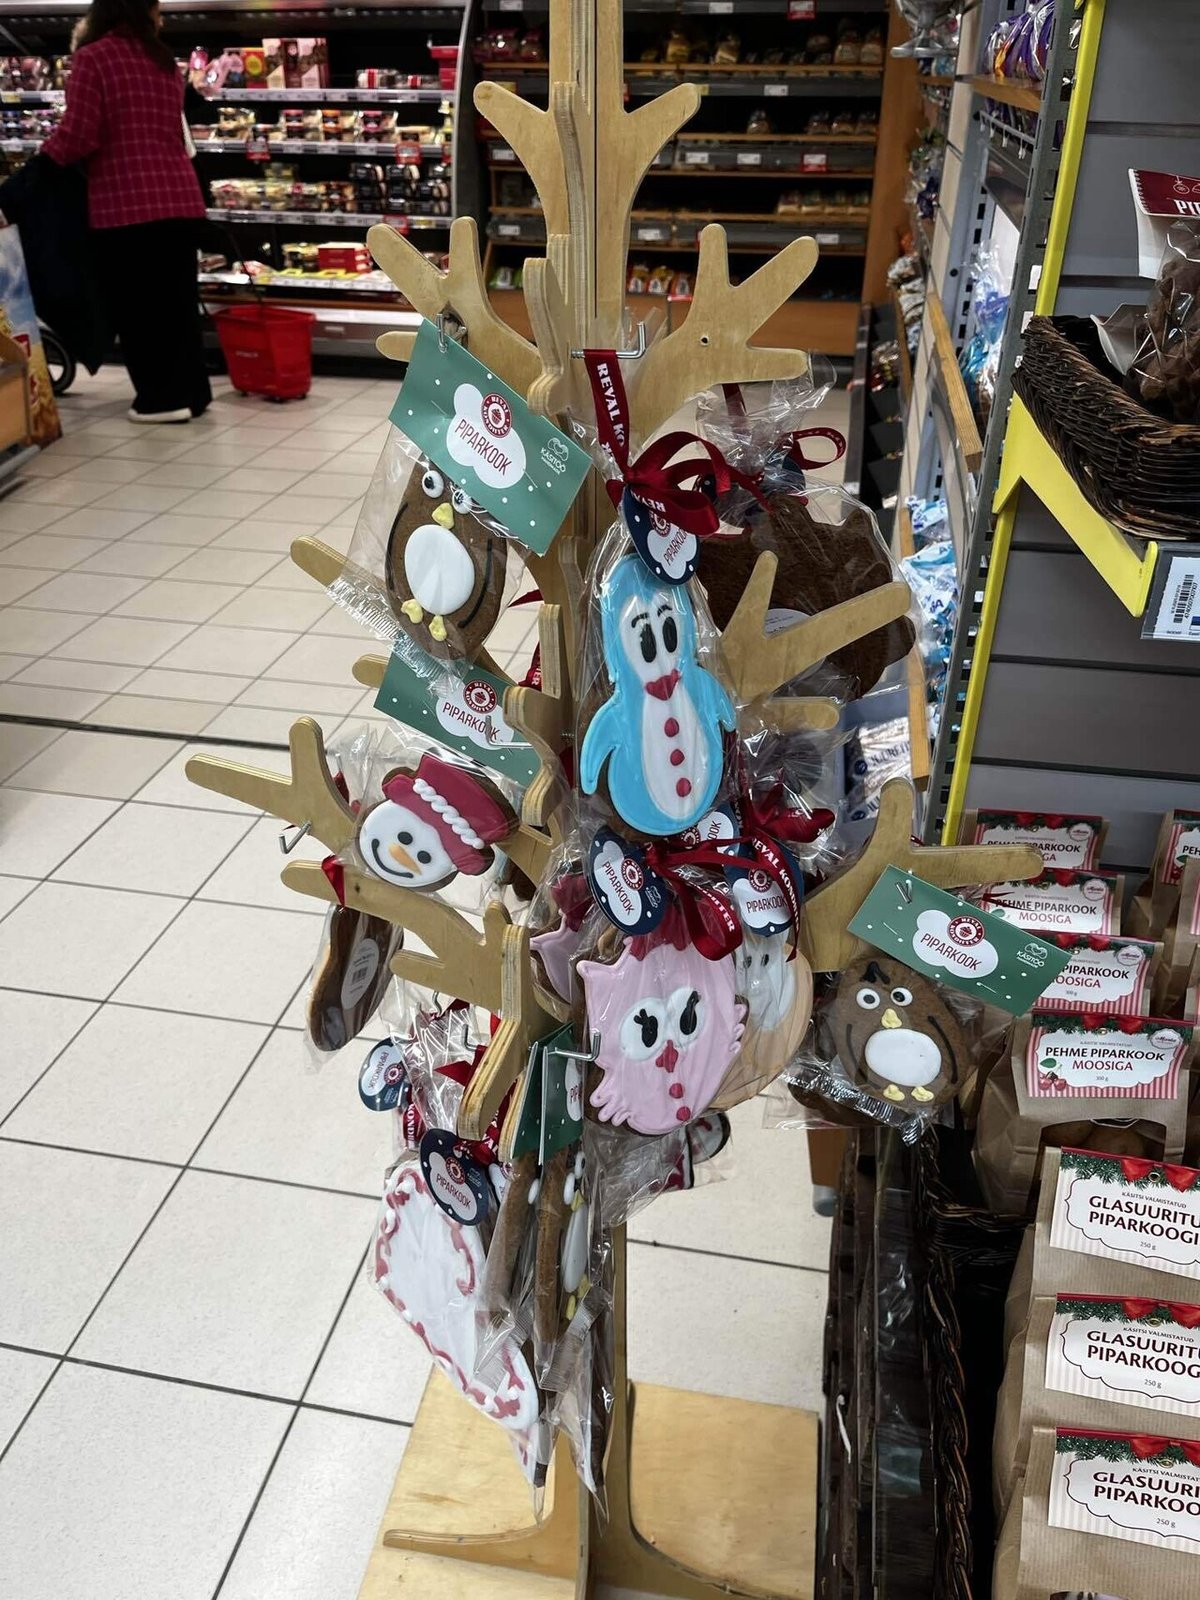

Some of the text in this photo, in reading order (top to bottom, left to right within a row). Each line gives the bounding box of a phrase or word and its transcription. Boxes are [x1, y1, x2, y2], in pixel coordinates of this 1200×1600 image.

[597, 362, 620, 421] REVAL
[455, 418, 512, 476] PIPARKOOK
[443, 702, 500, 743] PIPARKOK
[602, 861, 635, 916] PIPARKOOK
[1034, 901, 1097, 915] PIPARKOOK
[1019, 912, 1072, 925] MOOSIGA
[920, 933, 982, 971] PIPARKOOK
[1062, 964, 1130, 979] PIPARKOOK
[1052, 974, 1101, 988] OOSIGA
[1045, 1046, 1165, 1061] PEHME PIPARKOOK
[1072, 1060, 1133, 1071] MOOSIGA
[1145, 1195, 1187, 1209] VALMISTATUD
[1089, 1211, 1199, 1245] PIPARKOOGI
[1140, 1241, 1151, 1249] 250
[1149, 1330, 1194, 1343] VALMISTATUD
[1087, 1330, 1200, 1359] GLASUURIT
[1087, 1344, 1200, 1378] PIPARKOOG
[1144, 1379, 1156, 1387] 250
[1132, 1467, 1159, 1475] KÄSITSI
[1093, 1471, 1200, 1498] GLASUURI
[1094, 1485, 1200, 1516] PIPARKOO
[1156, 1517, 1169, 1526] 250
